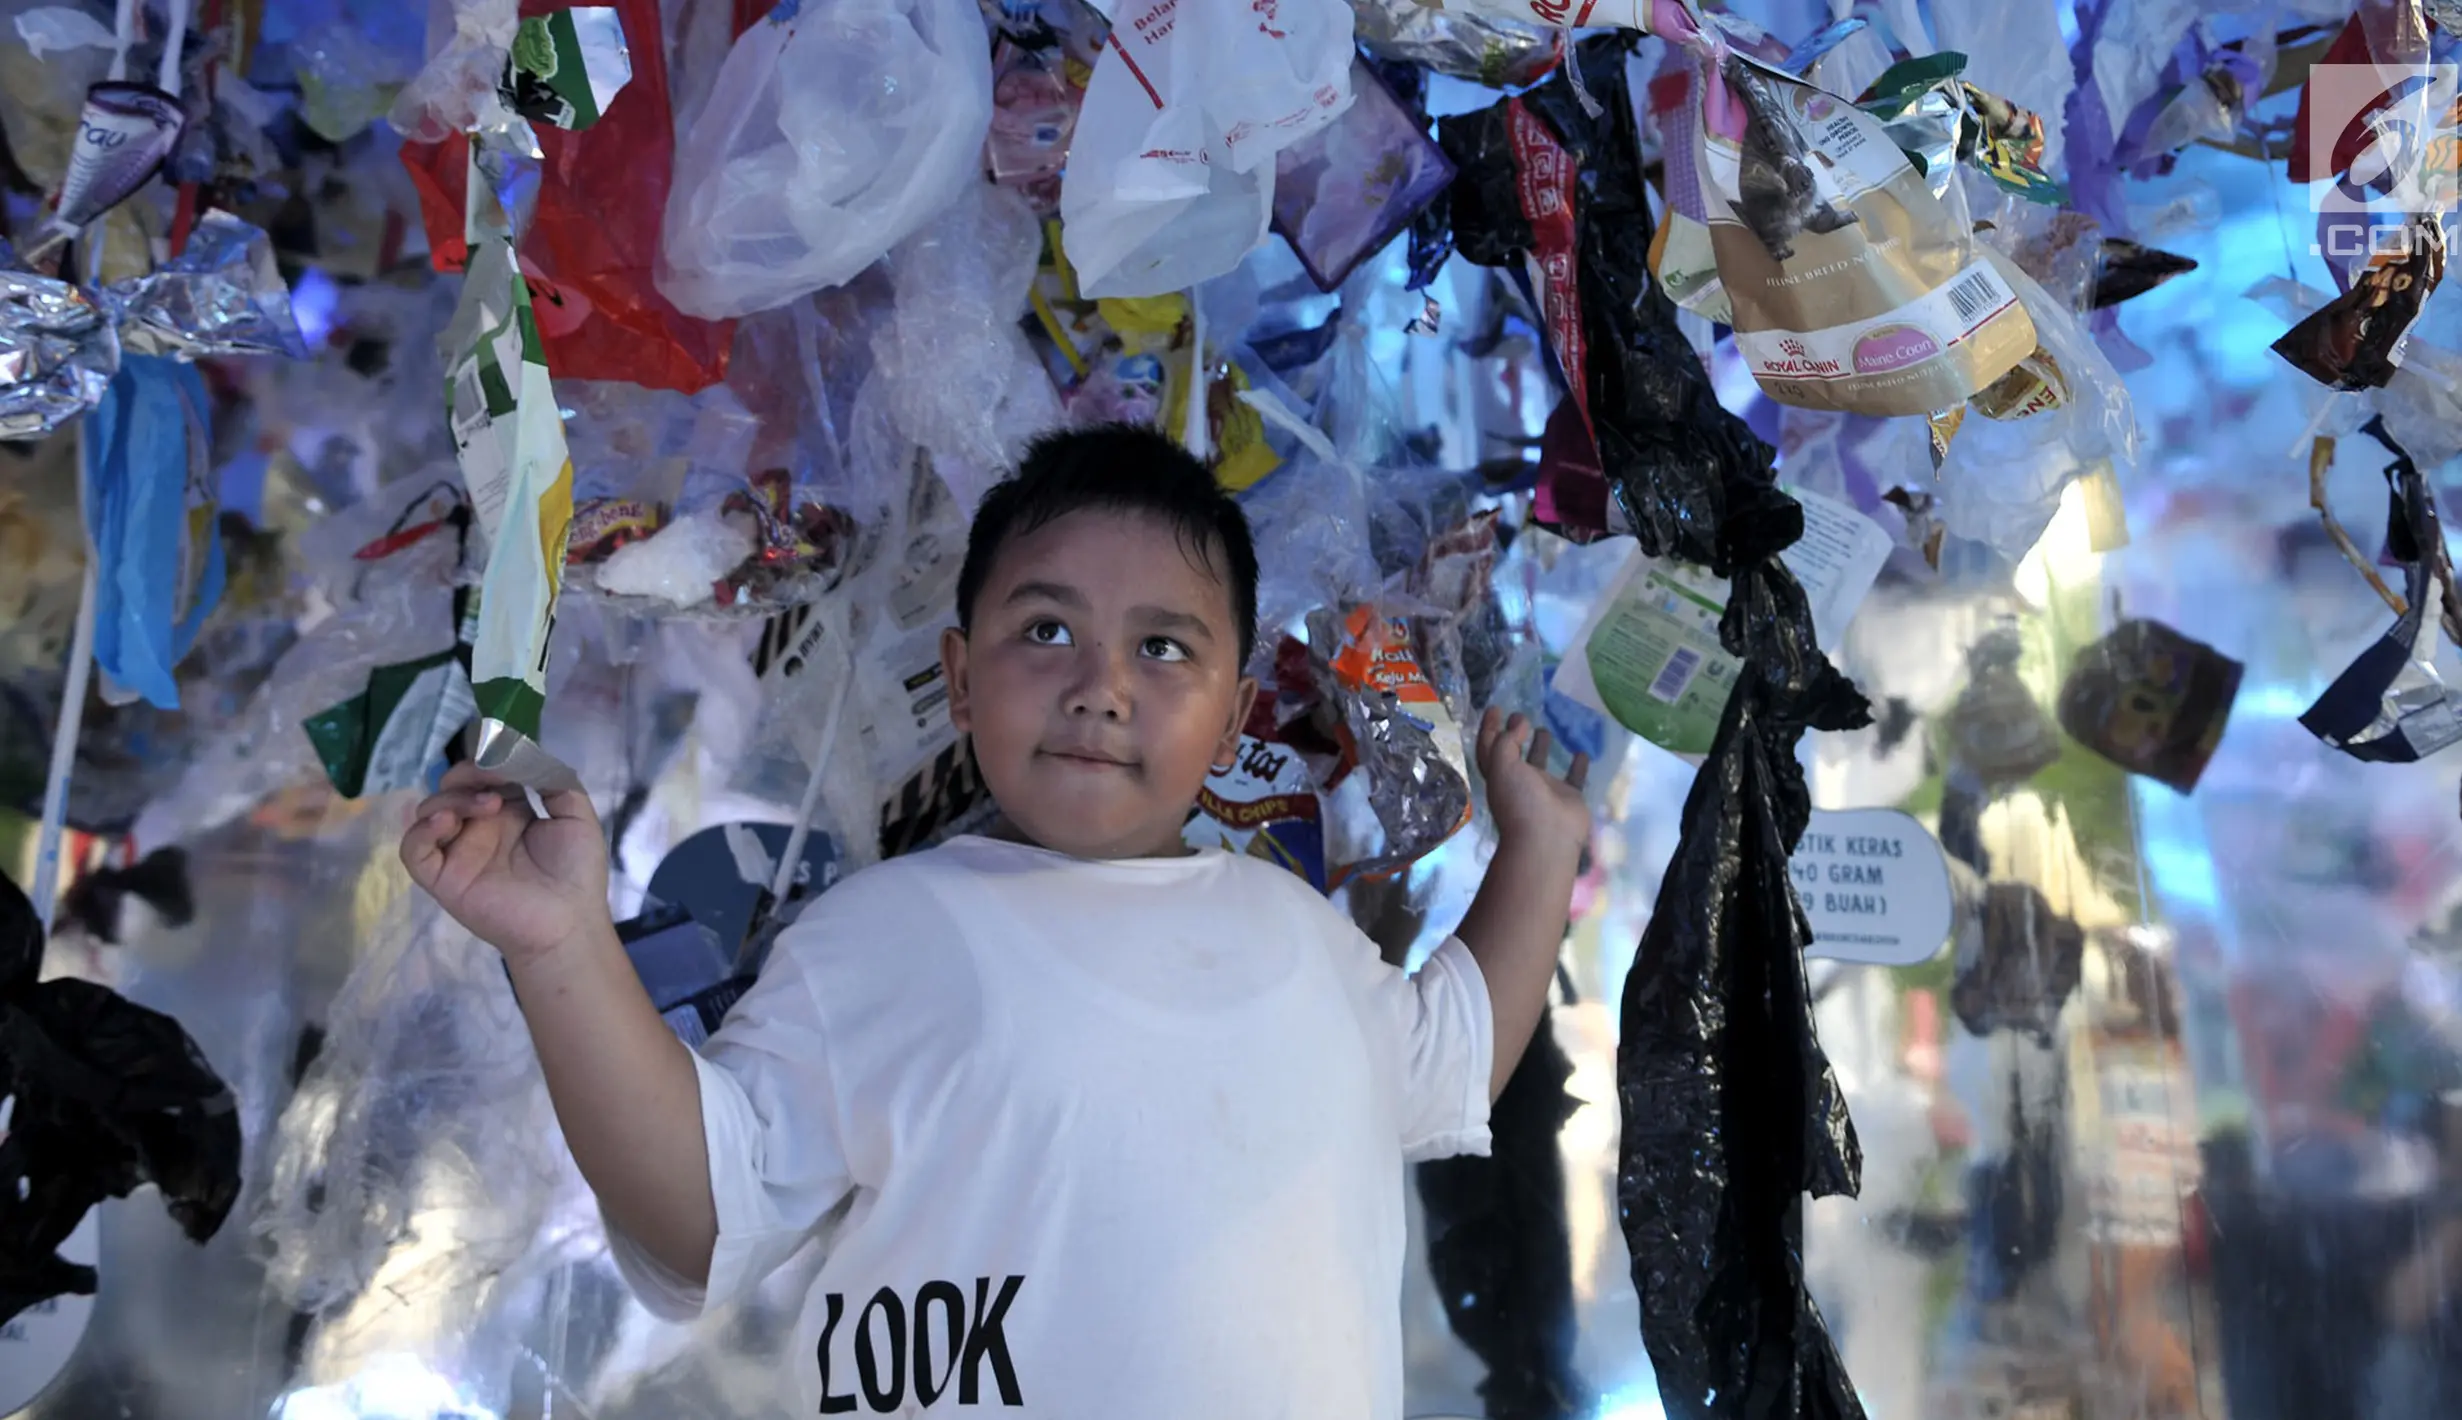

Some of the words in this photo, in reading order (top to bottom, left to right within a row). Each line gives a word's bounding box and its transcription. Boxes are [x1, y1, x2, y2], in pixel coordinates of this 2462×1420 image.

[1858, 350, 1894, 370] Maine
[1895, 338, 1932, 359] Coon
[1763, 359, 1801, 374] ROYAL
[1846, 836, 1904, 858] KERAS
[1828, 863, 1884, 886] GRAM
[818, 1275, 1025, 1414] LOOK
